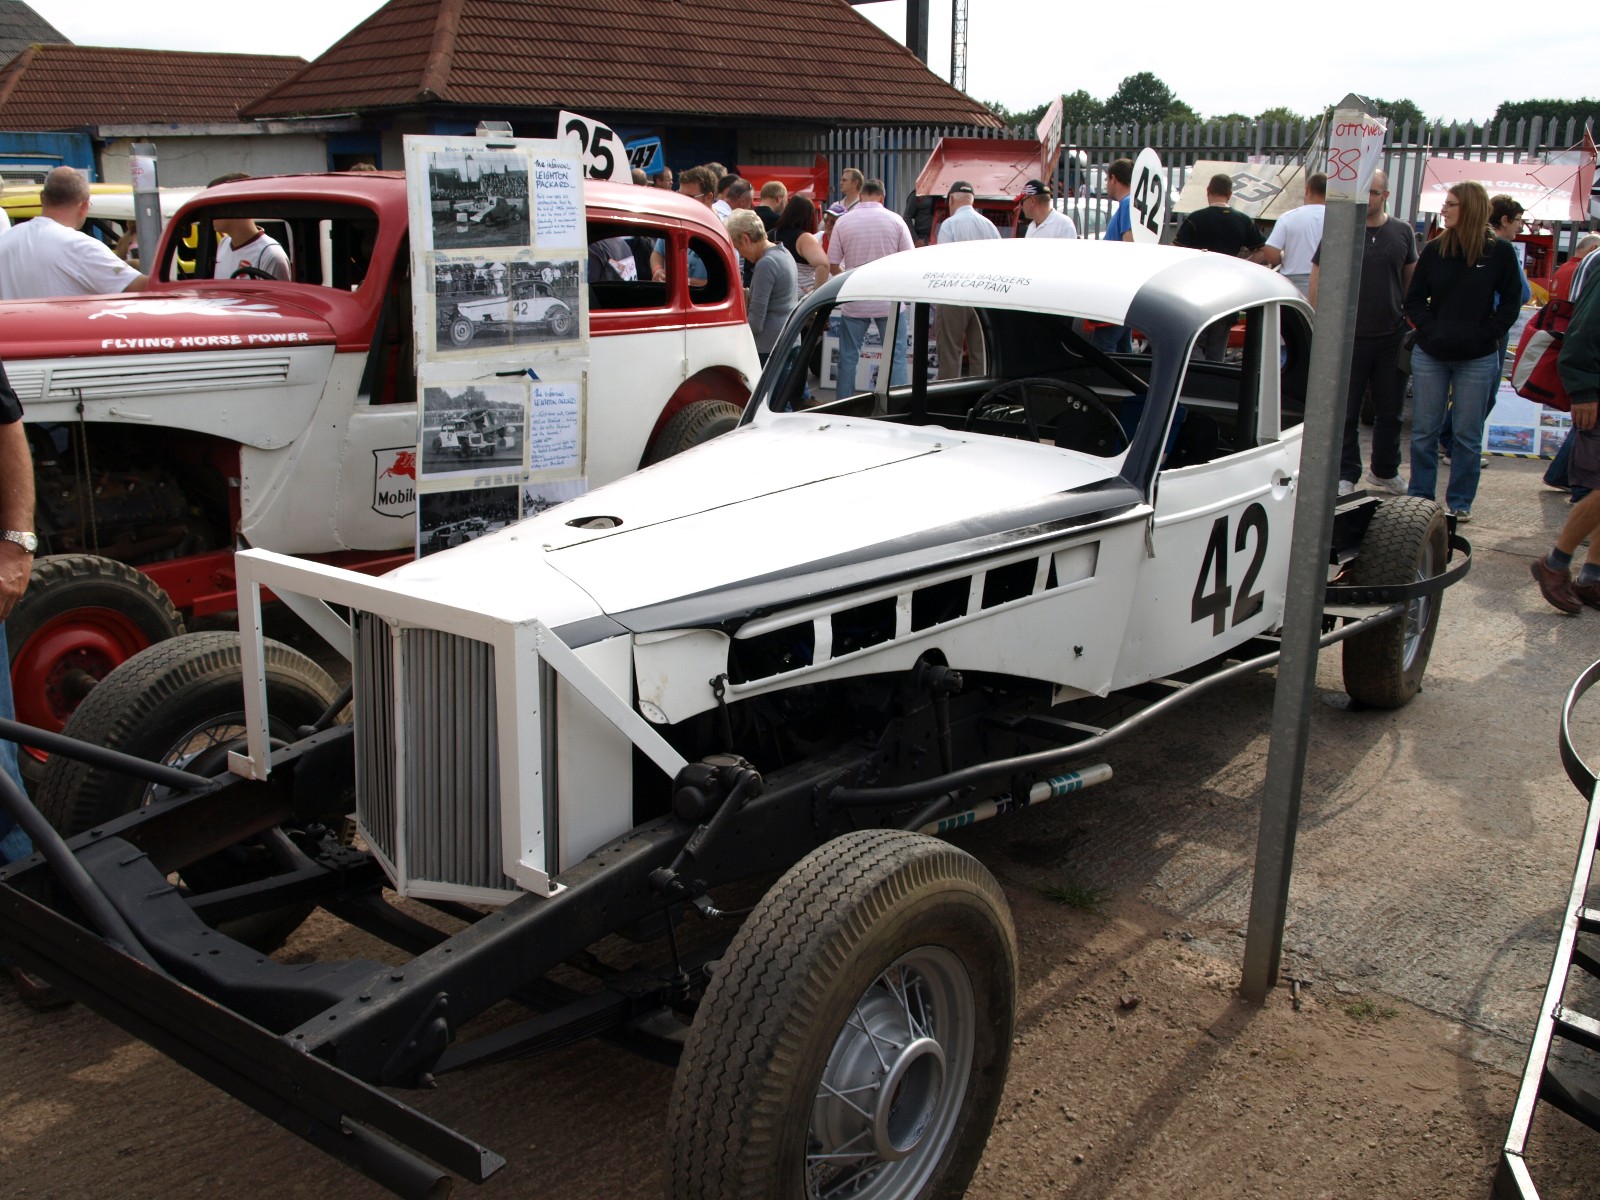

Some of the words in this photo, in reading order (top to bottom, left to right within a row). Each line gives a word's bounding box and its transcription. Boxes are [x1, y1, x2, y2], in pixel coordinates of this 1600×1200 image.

[536, 170, 568, 180] LEIGHTON
[1134, 166, 1162, 236] 42
[923, 272, 975, 280] BRAFIELD
[977, 274, 1032, 286] BADGERS
[927, 280, 959, 289] TEAM
[960, 280, 1011, 294] CAPTAIN
[513, 302, 528, 316] 42
[101, 337, 176, 348] FLYING
[180, 335, 242, 346] HORSE
[248, 332, 309, 344] POWER
[1191, 502, 1269, 637] 42
